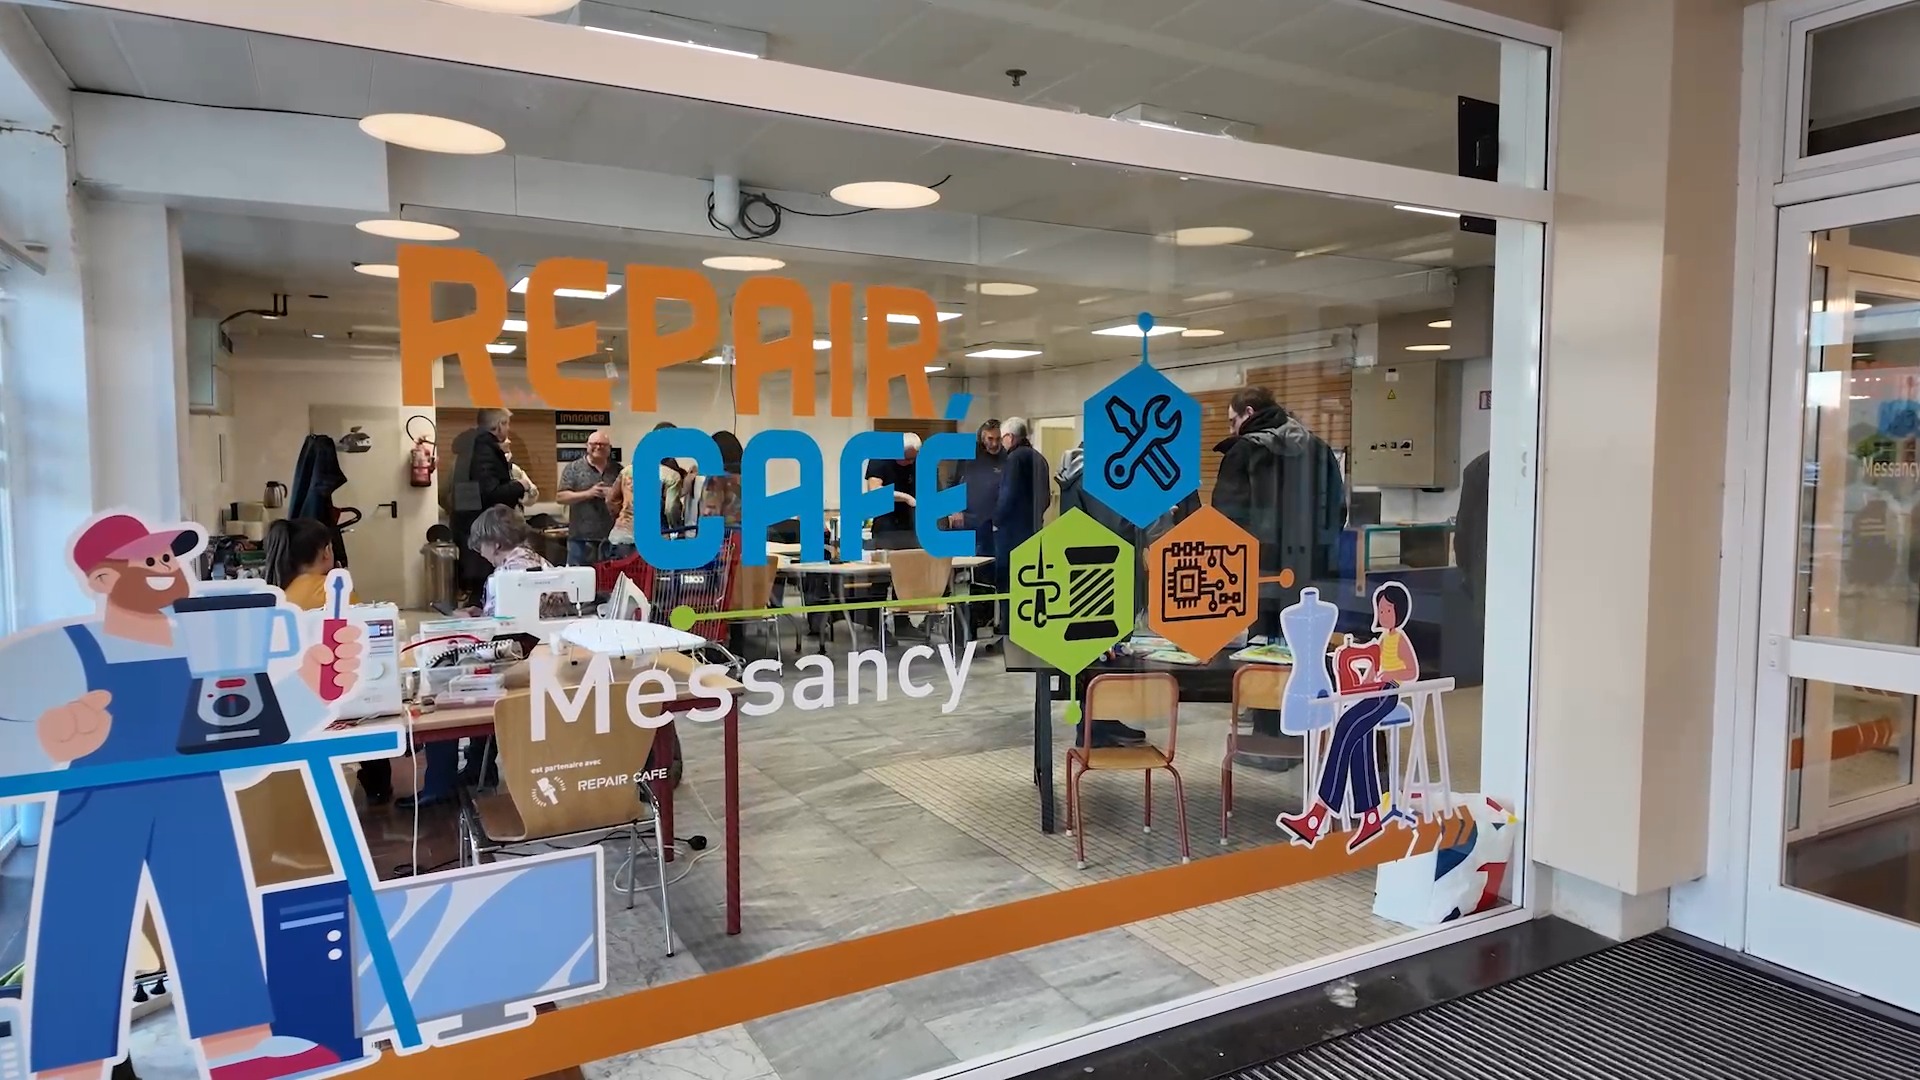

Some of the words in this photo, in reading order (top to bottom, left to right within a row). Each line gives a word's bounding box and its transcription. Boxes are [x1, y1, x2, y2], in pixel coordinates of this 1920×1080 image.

[397, 244, 940, 419] REPAIR
[632, 394, 977, 572] CAFÉ
[1862, 456, 1920, 482] Messancy
[529, 640, 978, 742] Messancy
[530, 765, 544, 774] est
[544, 761, 583, 773] partenaire
[585, 758, 602, 767] avec
[577, 774, 629, 792] REPAIR
[632, 767, 669, 783] CAFE
